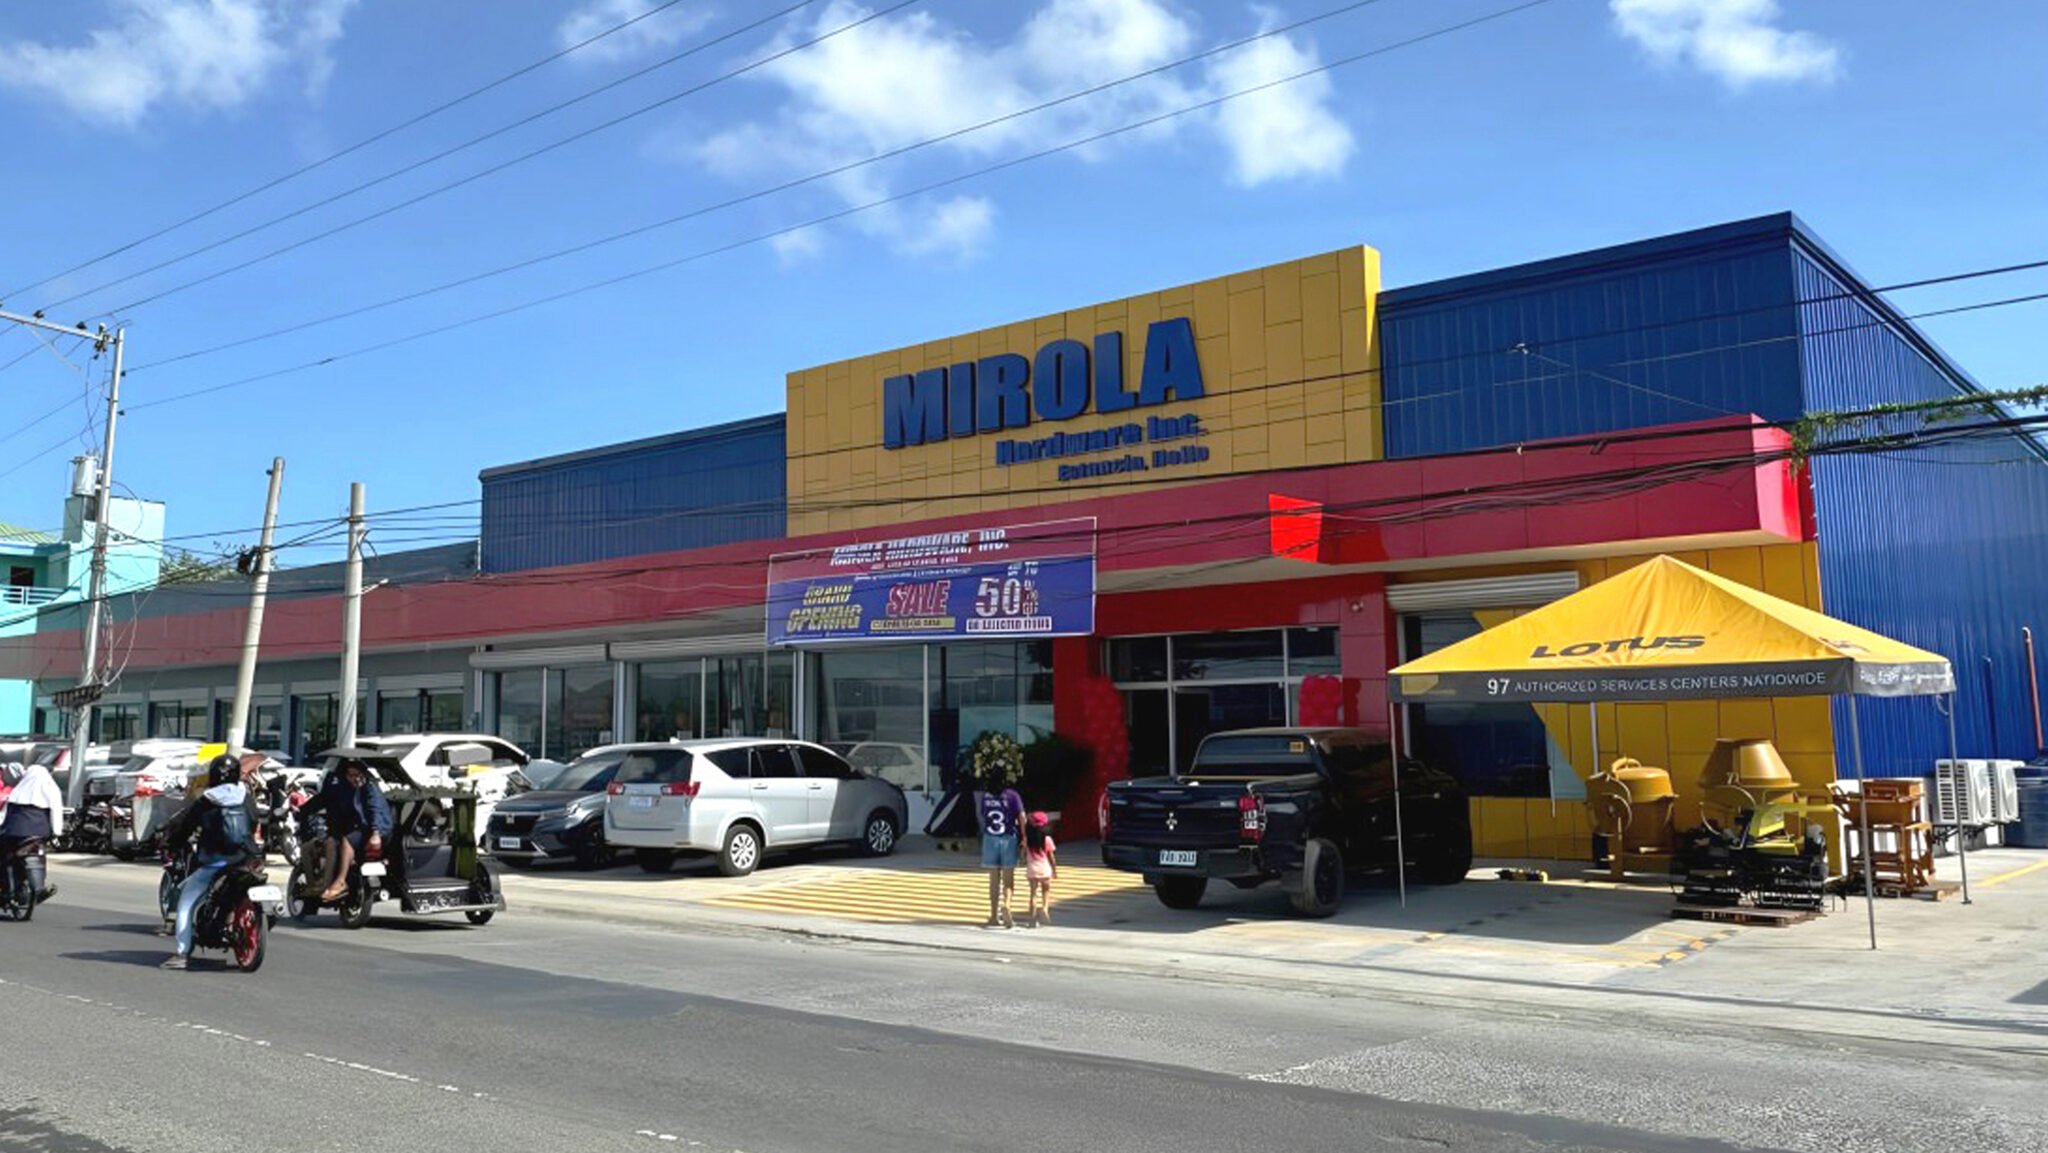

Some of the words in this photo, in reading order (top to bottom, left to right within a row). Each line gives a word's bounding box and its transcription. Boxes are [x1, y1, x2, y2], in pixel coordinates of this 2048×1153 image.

[884, 317, 1205, 450] MIROLA
[996, 423, 1142, 467] Hardware
[1147, 413, 1208, 442] Inc.
[886, 579, 951, 617] SALE
[1530, 635, 1706, 659] LOTUS
[1487, 678, 1511, 695] 97
[1514, 679, 1597, 693] AUTHORIZED
[1601, 678, 1668, 692] SERVICES
[1670, 675, 1738, 691] CENTERS
[986, 810, 1006, 836] 3
